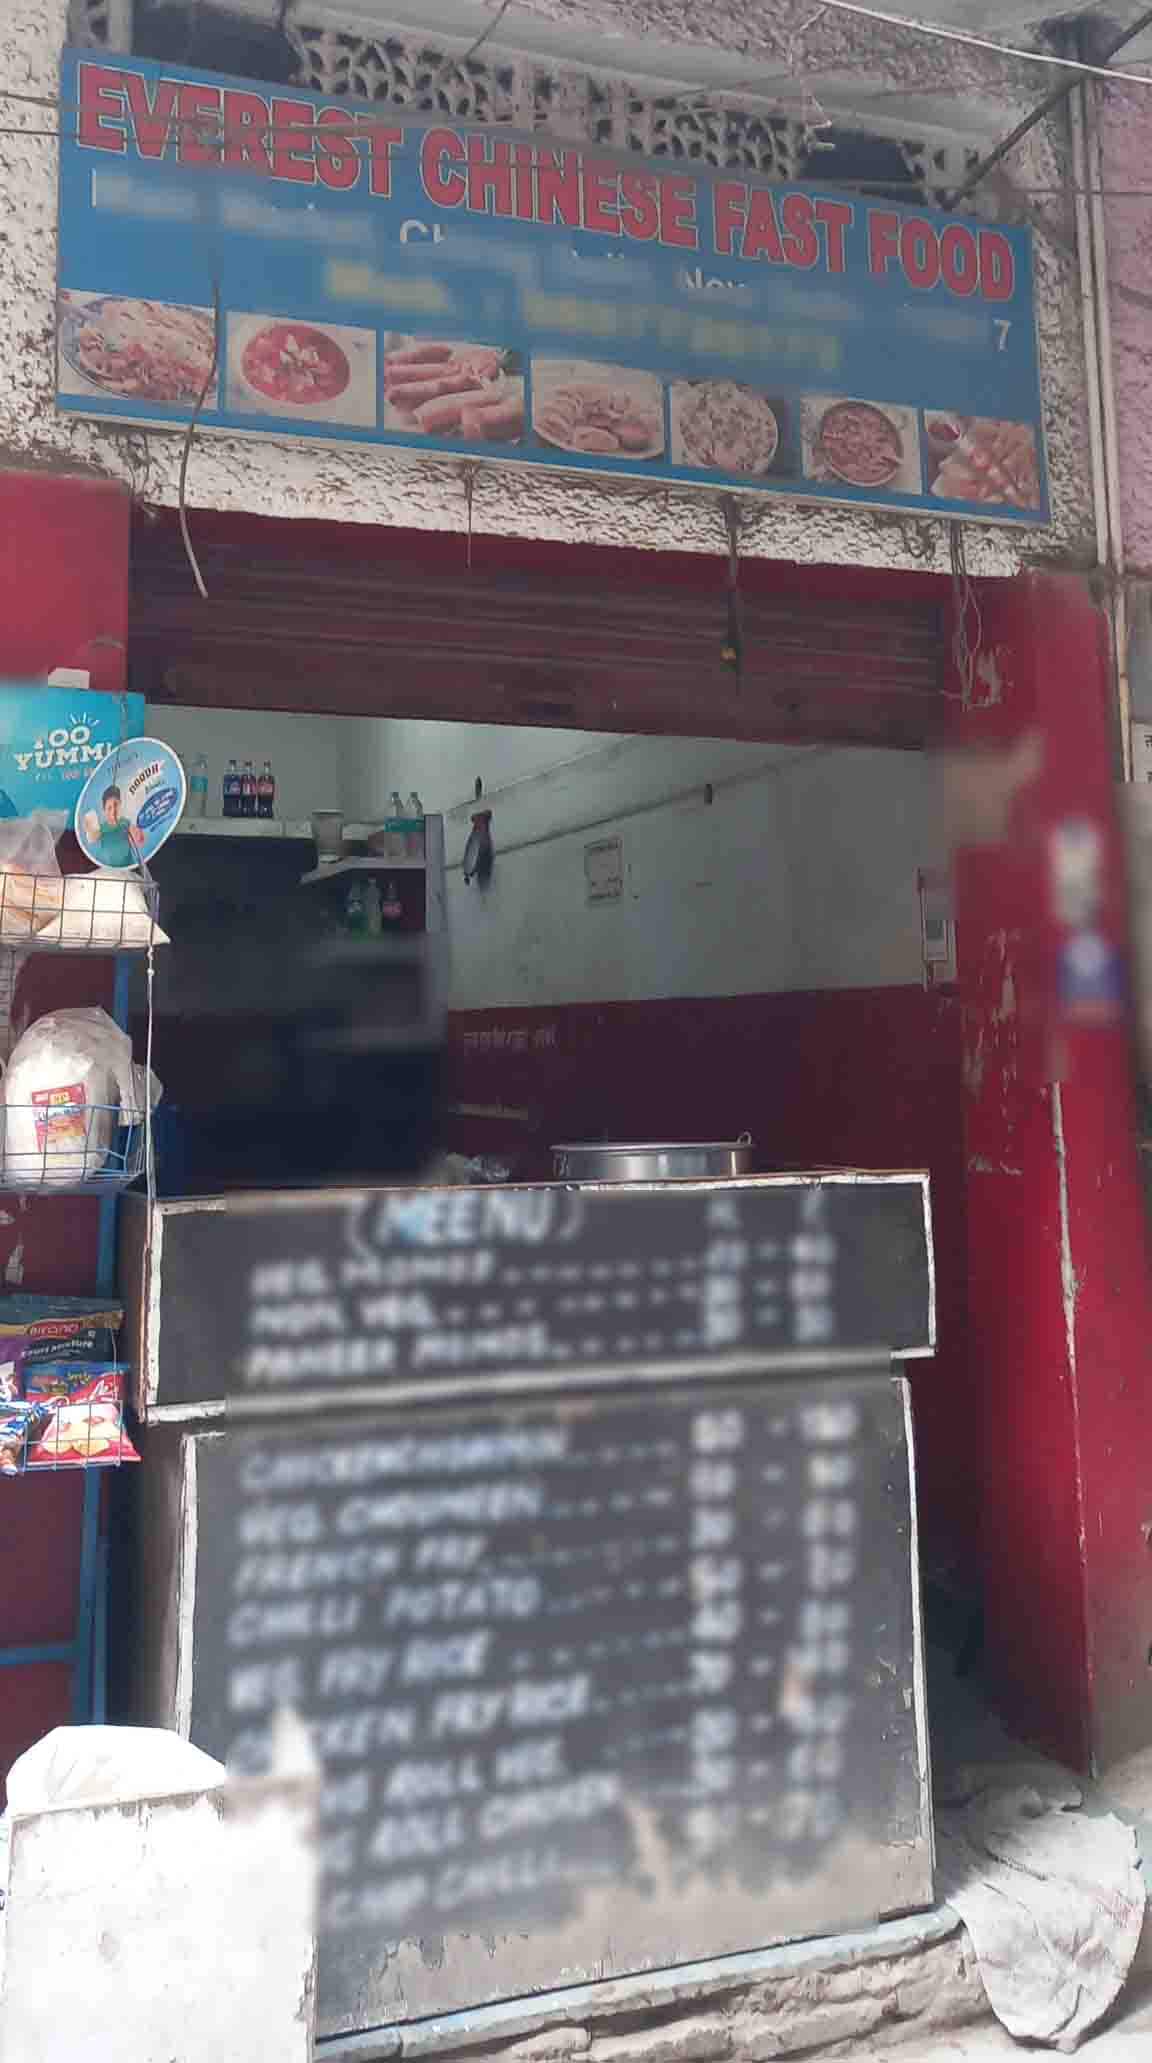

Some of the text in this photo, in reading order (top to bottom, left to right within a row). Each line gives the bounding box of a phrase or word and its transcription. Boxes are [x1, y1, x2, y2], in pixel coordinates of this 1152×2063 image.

[76, 61, 405, 199] EVEREST
[419, 126, 701, 249] CHINESE
[710, 181, 855, 273] FAST
[864, 207, 1017, 302] FOOD
